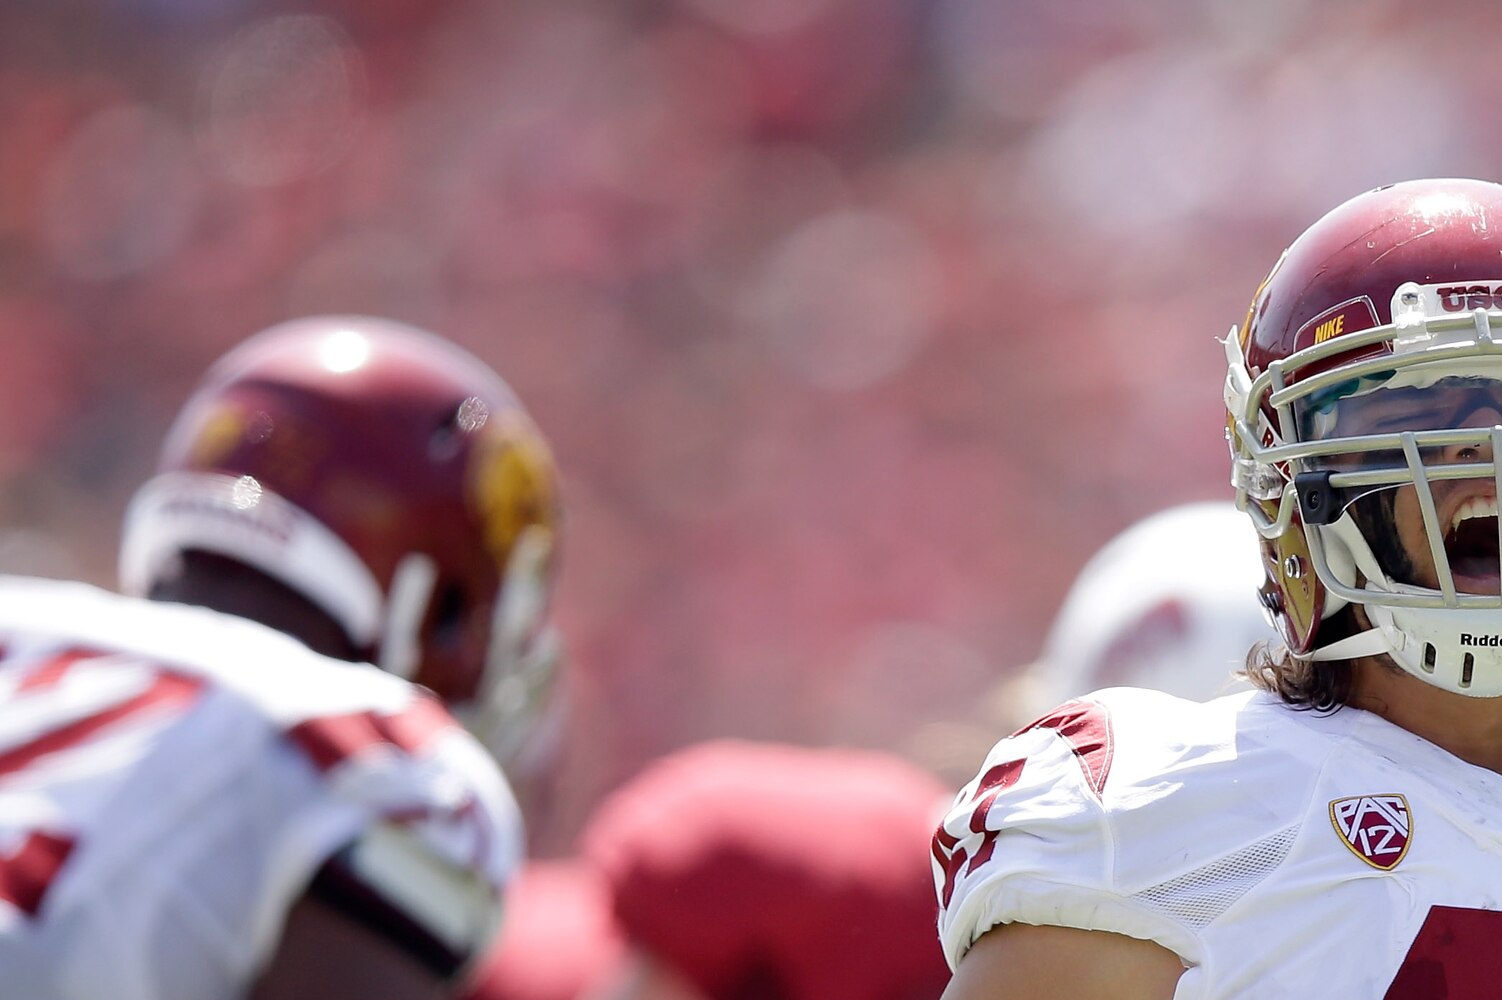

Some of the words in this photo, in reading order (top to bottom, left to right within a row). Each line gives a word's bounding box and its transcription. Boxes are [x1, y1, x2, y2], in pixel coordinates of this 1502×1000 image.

[1314, 314, 1345, 344] NIKE
[1334, 797, 1410, 845] PAC
[1358, 825, 1402, 857] 12
